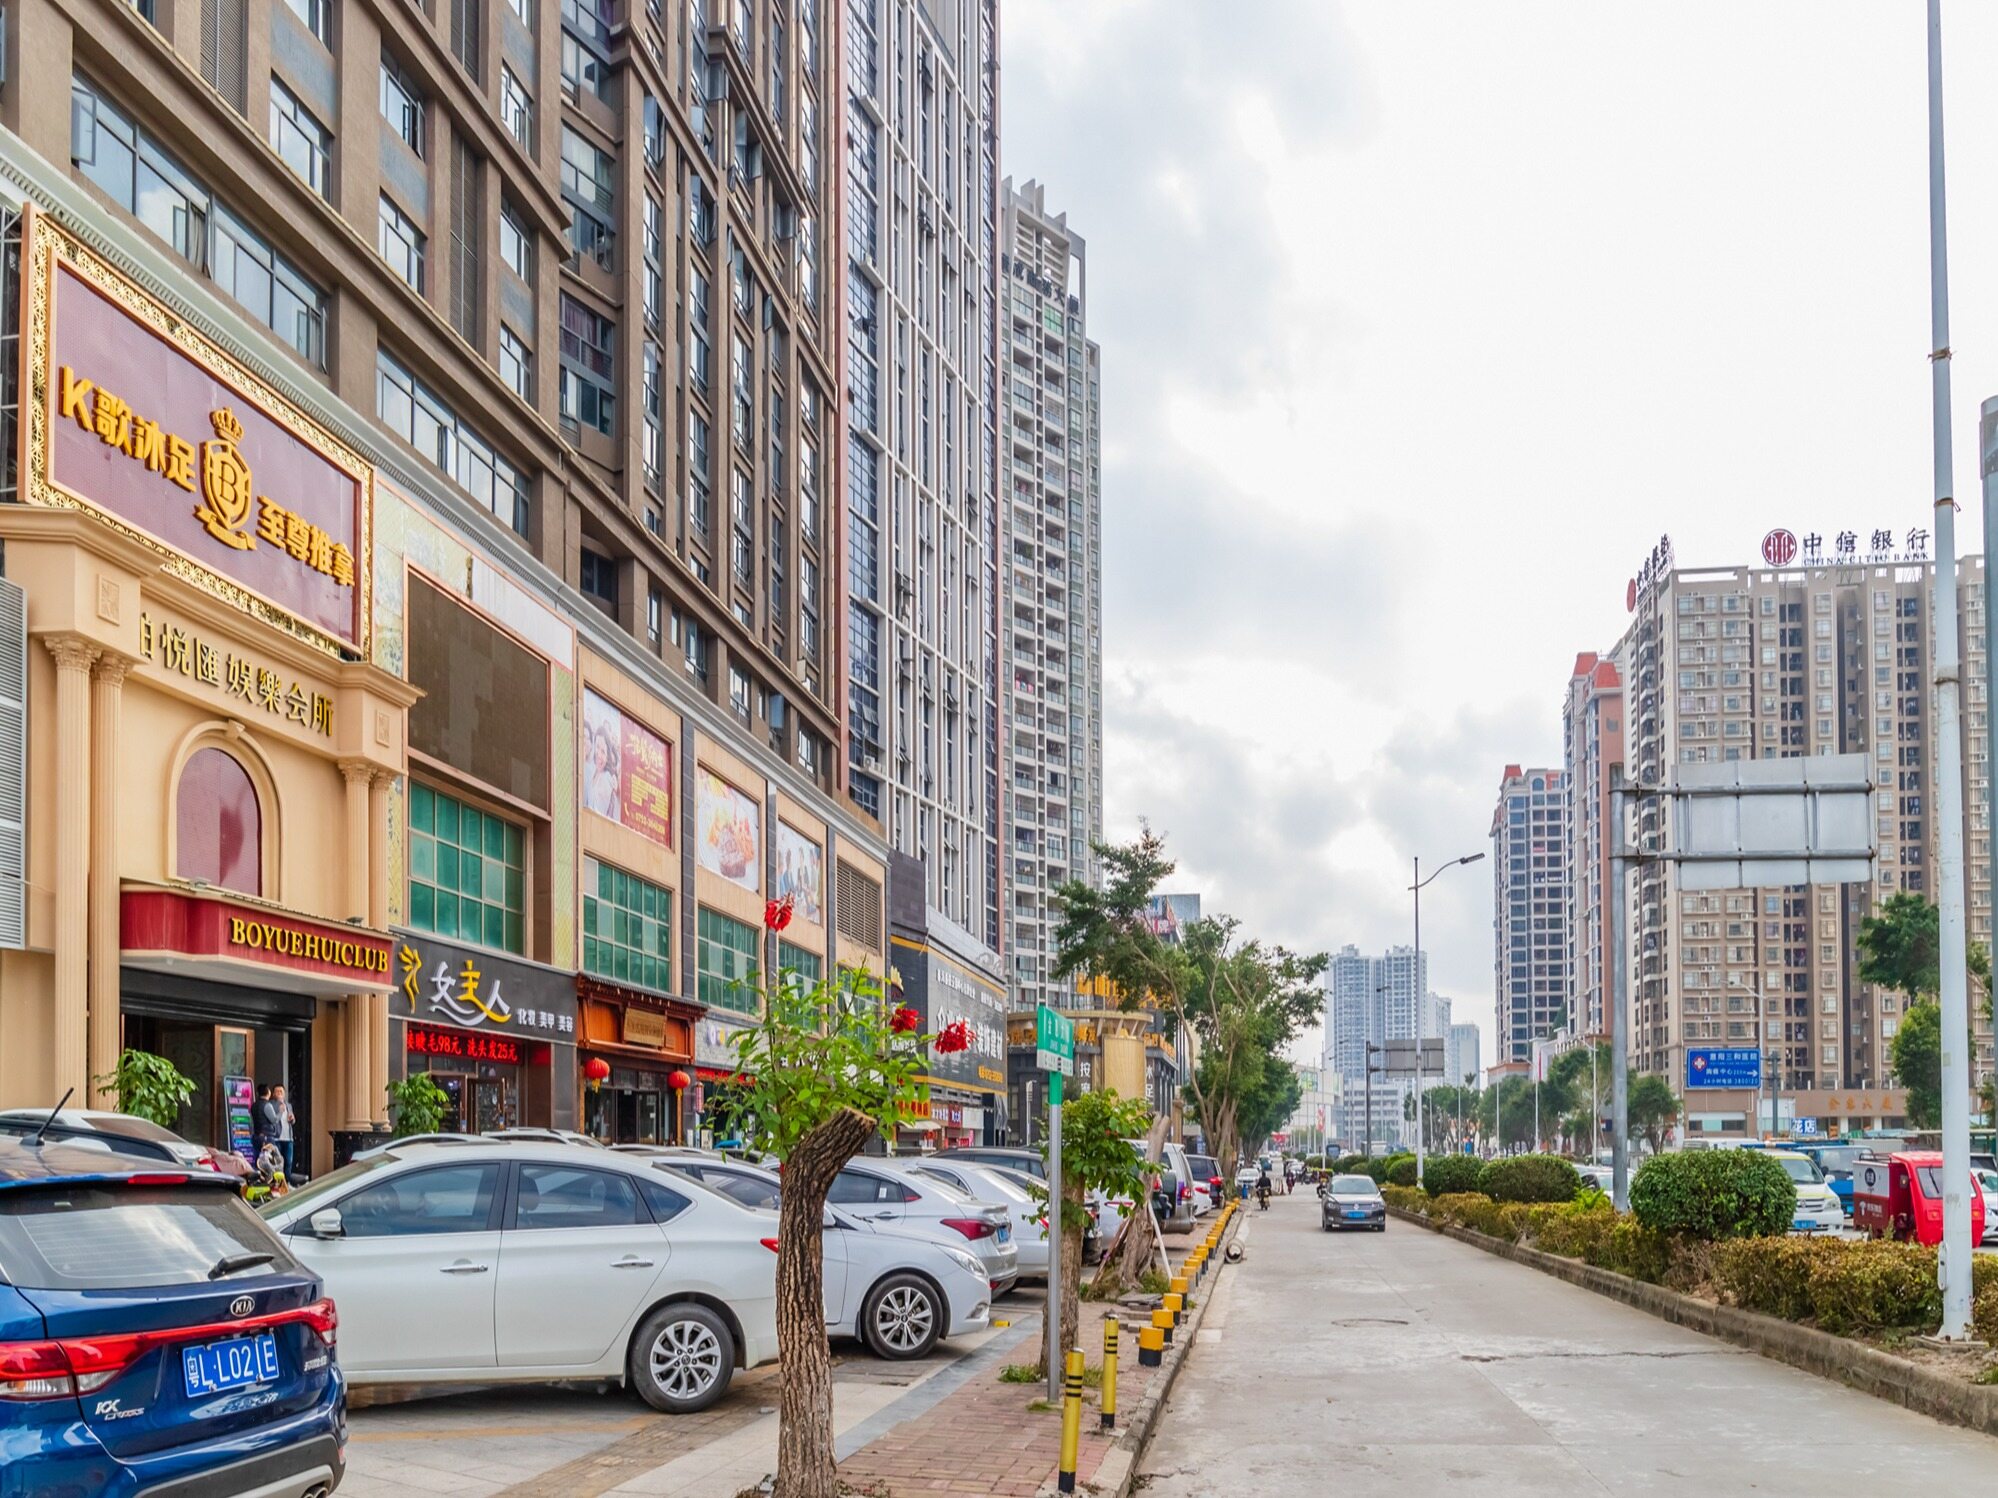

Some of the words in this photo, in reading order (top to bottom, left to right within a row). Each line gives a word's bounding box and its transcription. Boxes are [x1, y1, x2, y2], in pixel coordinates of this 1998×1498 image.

[60, 365, 197, 493] K歌沐足
[256, 495, 355, 587] 至尊推拿
[1804, 528, 1930, 556] 中信银行
[1804, 557, 1844, 566] CHINA
[1894, 553, 1929, 562] BANK
[231, 917, 388, 972] BOYUEHUICLUB
[429, 960, 512, 1026] 女主人
[540, 1011, 555, 1029] 美甲
[558, 1015, 573, 1033] 美容
[1791, 1118, 1816, 1135] 花店
[235, 1300, 253, 1314] KIA
